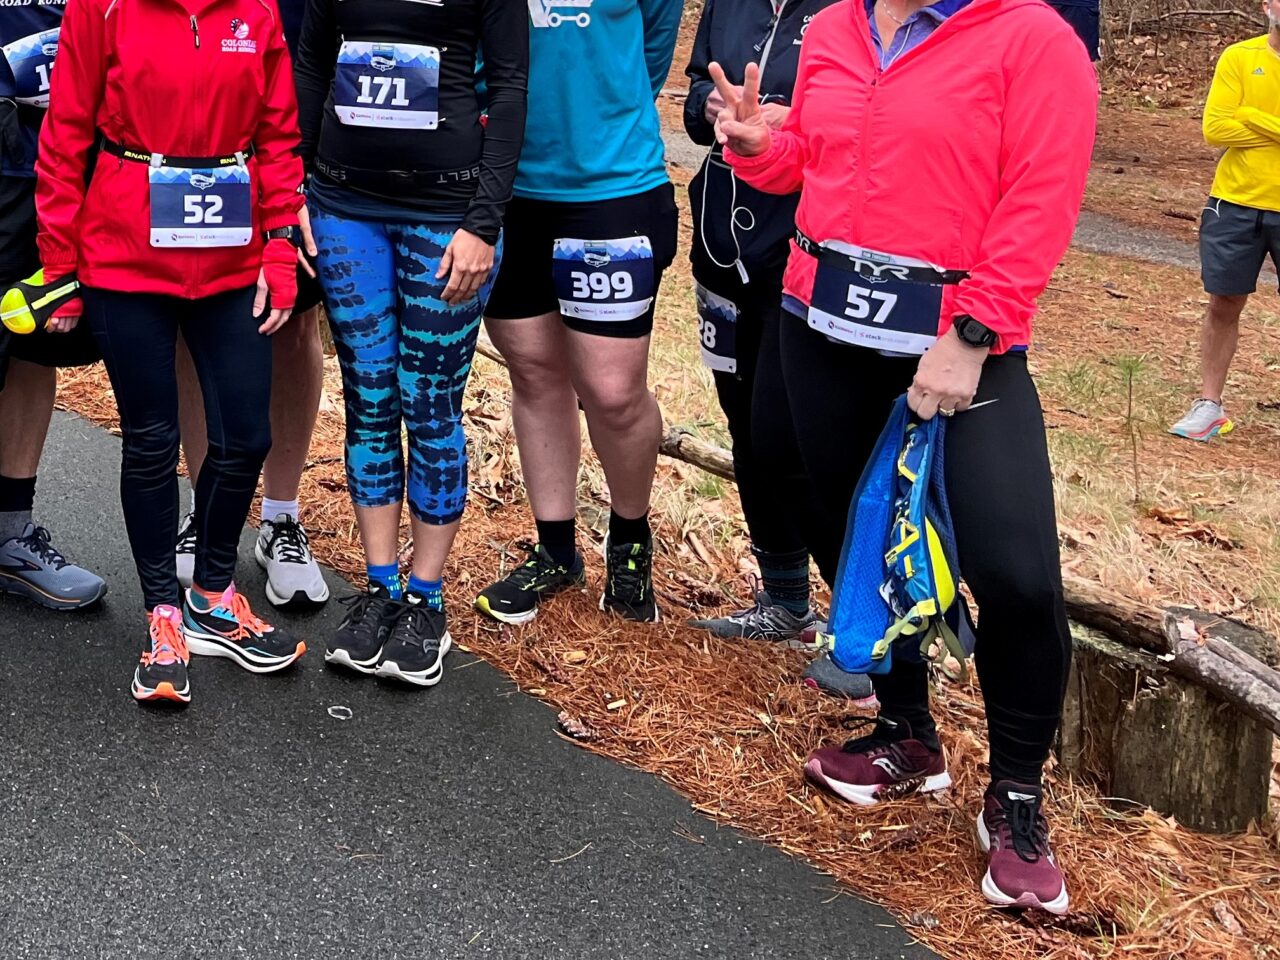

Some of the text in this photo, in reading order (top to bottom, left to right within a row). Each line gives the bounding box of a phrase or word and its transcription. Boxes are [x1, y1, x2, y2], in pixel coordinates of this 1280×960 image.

[35, 61, 56, 92] 1
[356, 75, 410, 107] 171
[131, 152, 167, 164] NATHN
[183, 195, 223, 224] 52
[796, 229, 811, 253] TYR
[848, 256, 910, 281] TYR
[571, 271, 634, 300] 399
[844, 283, 898, 324] 57
